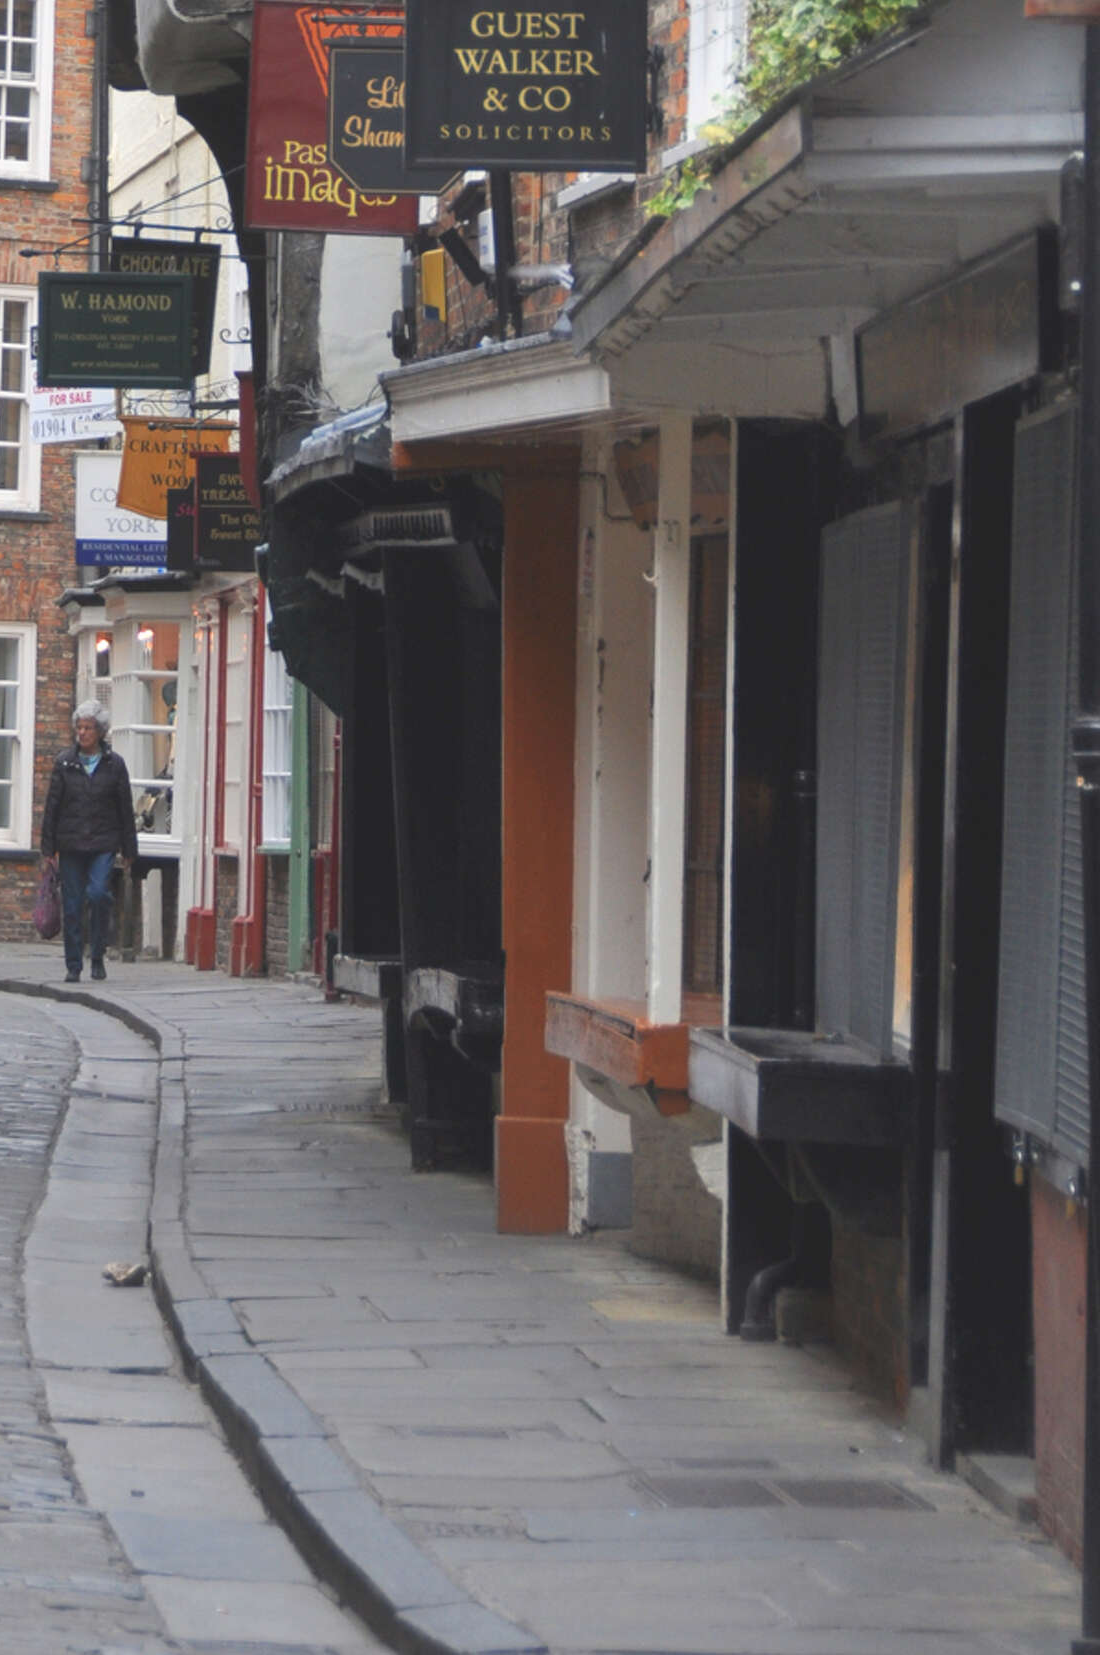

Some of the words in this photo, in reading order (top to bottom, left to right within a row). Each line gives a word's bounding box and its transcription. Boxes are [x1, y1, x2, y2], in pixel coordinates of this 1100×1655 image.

[470, 11, 585, 40] GUEST
[454, 47, 600, 76] WALKER
[483, 87, 508, 112] &
[518, 86, 571, 112] CO
[440, 124, 612, 141] SOLICITORS
[284, 140, 327, 165] Pas
[119, 254, 211, 277] CHOCOLATE
[61, 290, 82, 310] W.
[88, 293, 172, 311] HAMOND
[101, 313, 130, 325] YORK
[49, 394, 67, 408] FOR
[68, 391, 92, 405] SALE
[32, 417, 66, 438] 01904
[168, 458, 183, 470] IN
[150, 473, 193, 488] WOO
[90, 487, 117, 503] CO
[106, 517, 159, 534] YORK
[82, 542, 140, 552] RESIDENTIAL
[104, 553, 168, 563] MANAGEMENT
